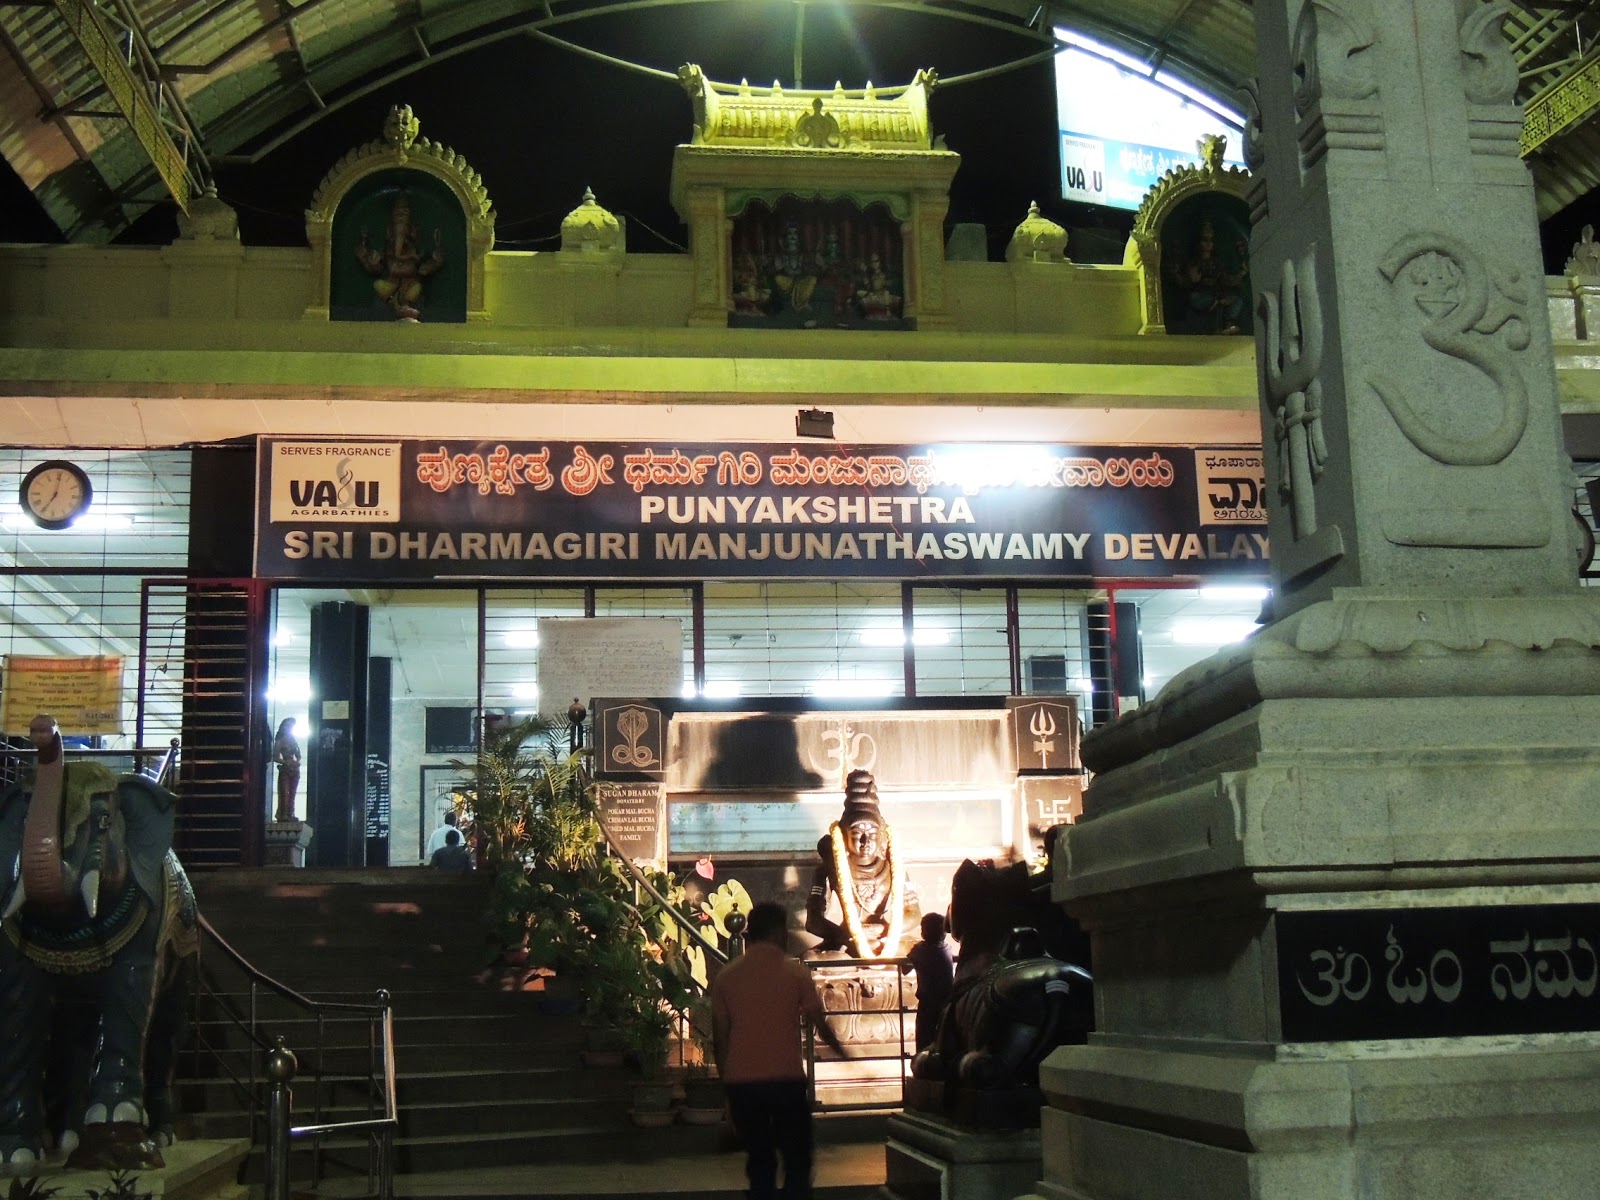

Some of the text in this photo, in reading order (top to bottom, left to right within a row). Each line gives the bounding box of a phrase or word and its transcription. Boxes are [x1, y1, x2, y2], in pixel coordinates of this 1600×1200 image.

[280, 446, 392, 457] SERVES FRAGRANCE
[417, 445, 555, 495] ಪುಣ್ಯಕ್ಷೇತ್ರ
[561, 445, 615, 496] ಶ್ರೀ
[624, 448, 763, 493] ಧರ್ಮಗಿರಿ
[290, 509, 390, 517] AGARBATHIES
[640, 496, 976, 524] PUNYAKSHETRA
[283, 531, 1270, 561] SRI DHARMAGIRI MANJUNATHASWAMY DEVALAY
